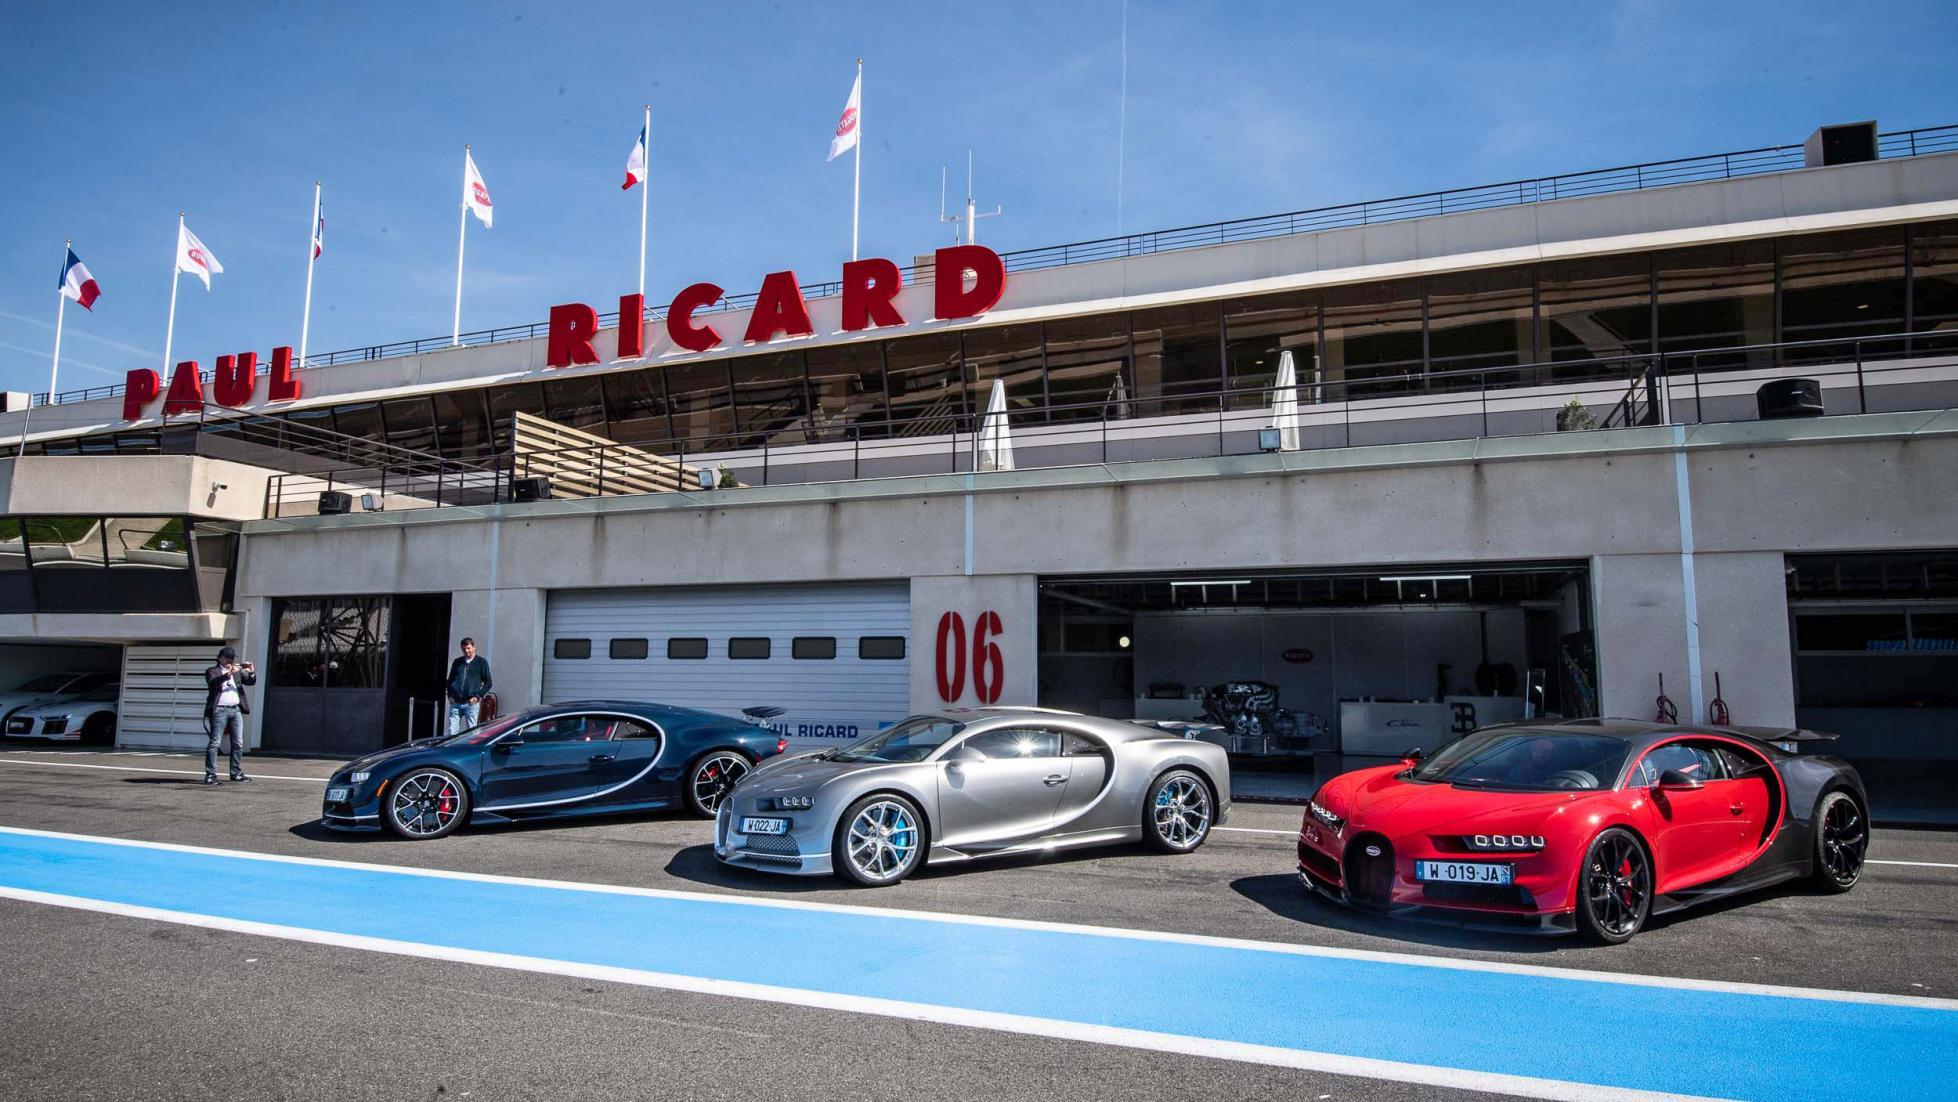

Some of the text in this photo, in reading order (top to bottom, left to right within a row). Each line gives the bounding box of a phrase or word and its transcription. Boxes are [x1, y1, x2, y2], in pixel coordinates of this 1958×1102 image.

[123, 245, 1006, 421] PAUL RICARD
[936, 611, 1003, 704] 06
[798, 724, 858, 738] RICARD
